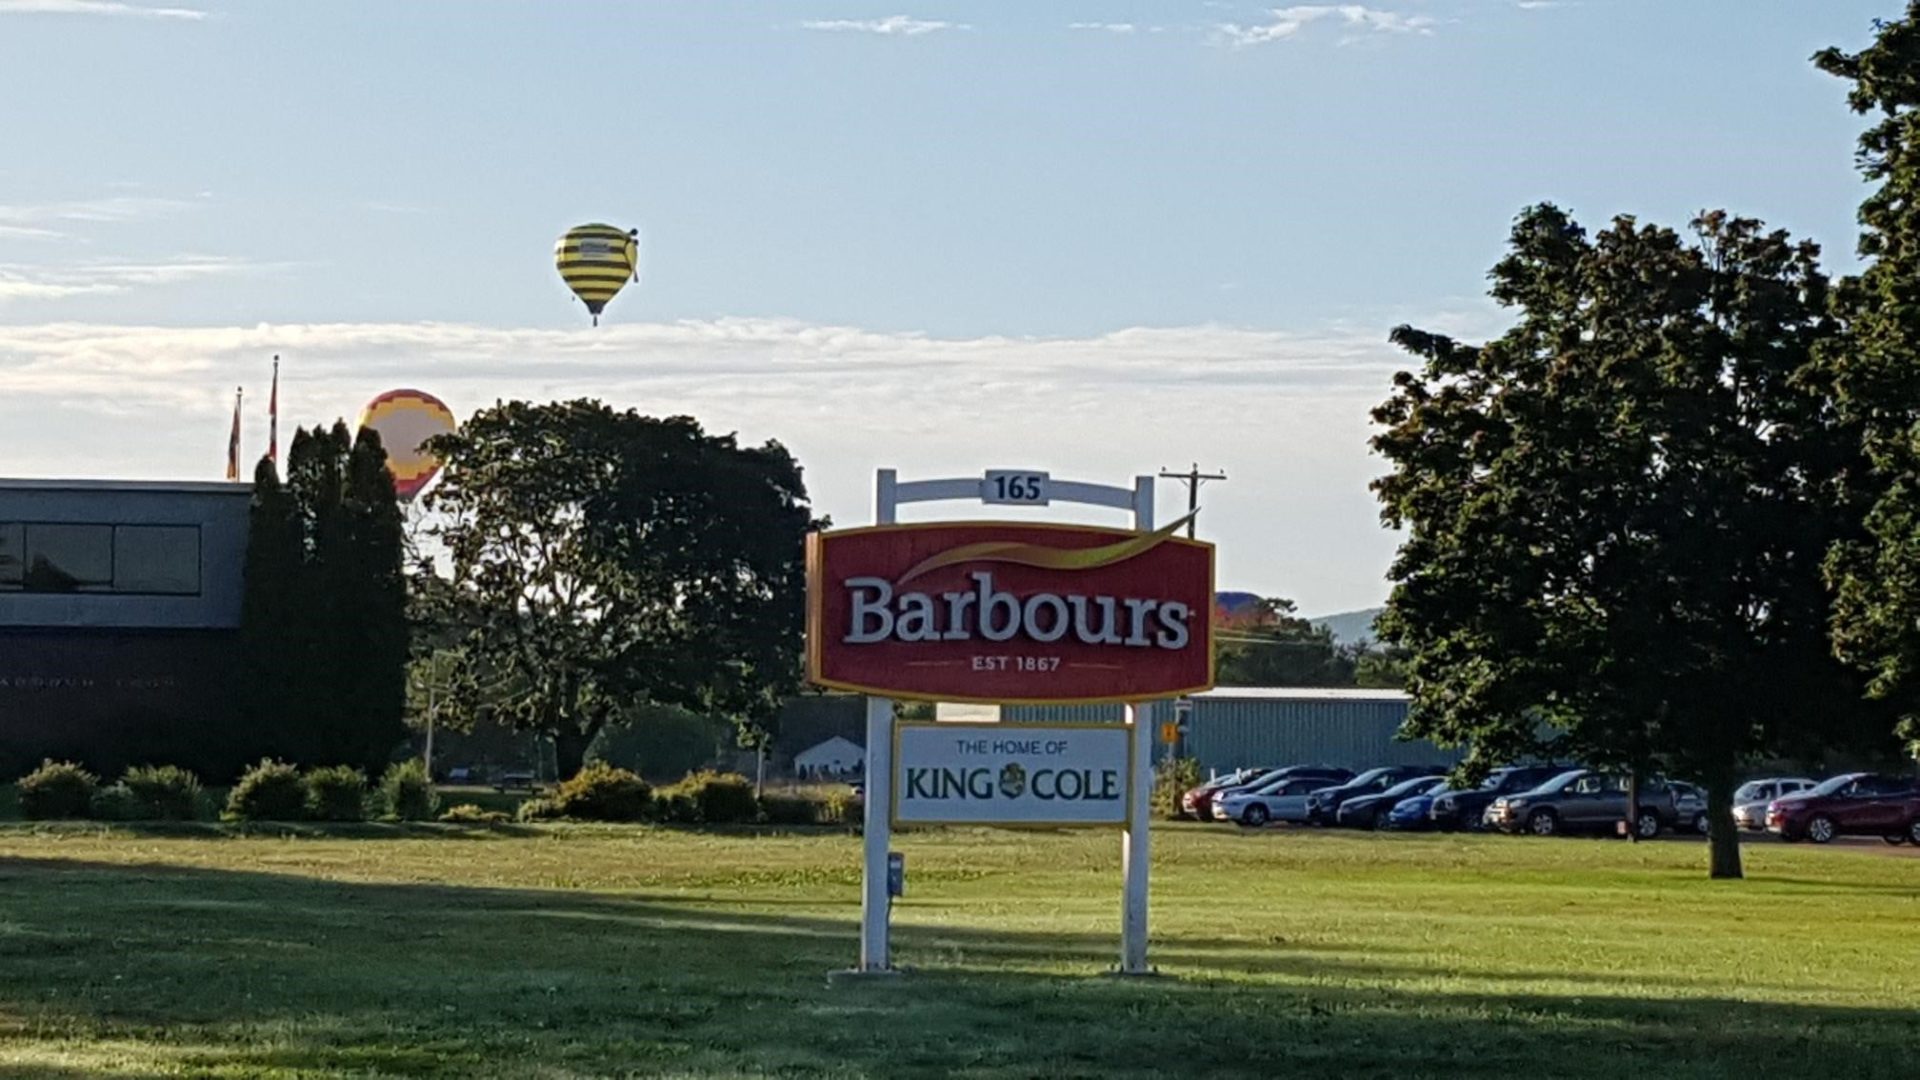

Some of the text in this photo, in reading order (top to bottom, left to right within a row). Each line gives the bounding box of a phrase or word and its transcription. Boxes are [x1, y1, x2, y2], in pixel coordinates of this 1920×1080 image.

[994, 476, 1041, 499] 165
[844, 571, 1189, 650] Barbours
[972, 656, 1060, 671] EST 1867
[957, 740, 1067, 755] THE HOME OF
[906, 767, 1120, 800] KING COLE
